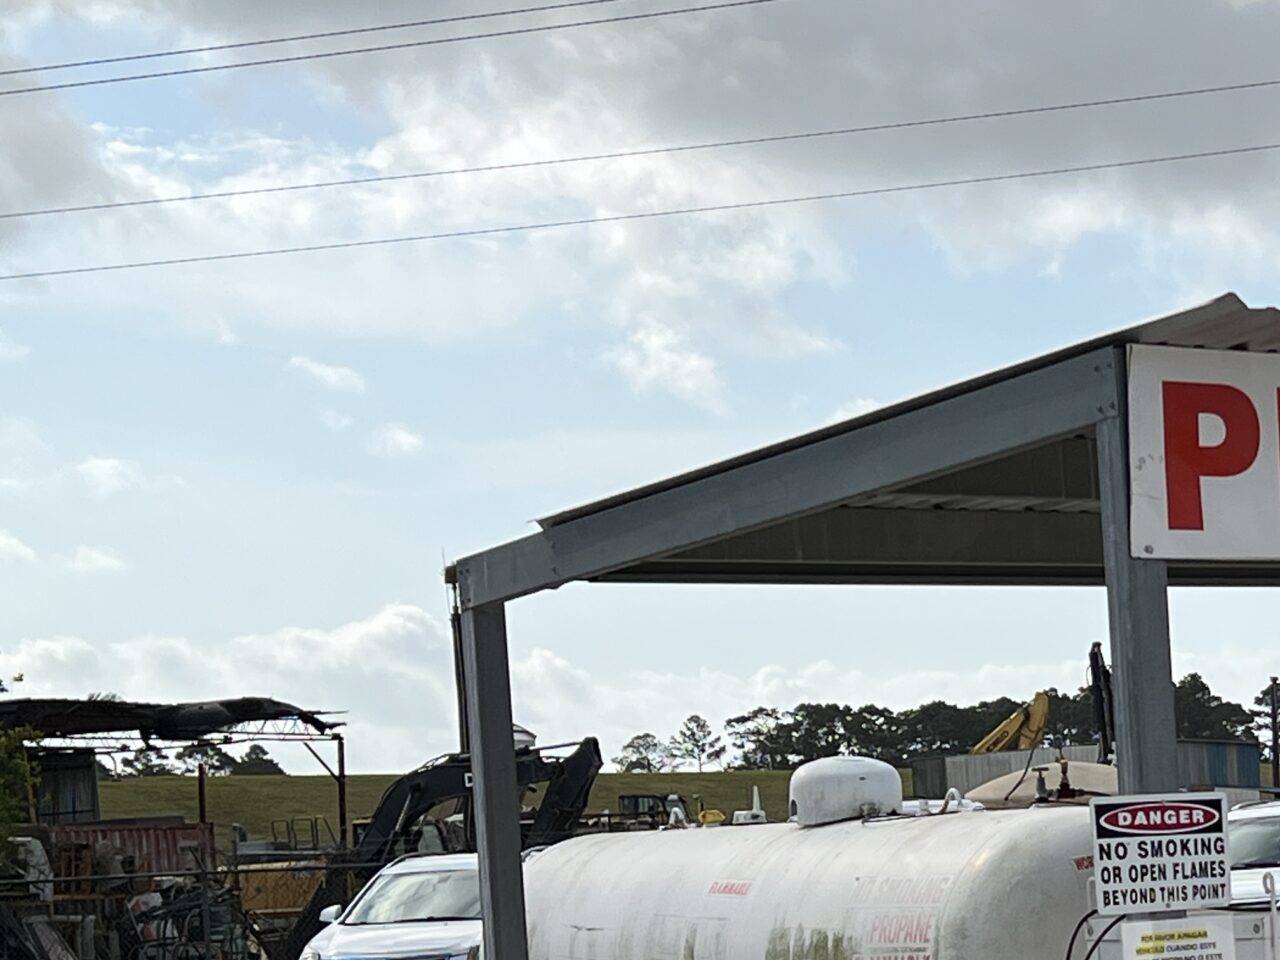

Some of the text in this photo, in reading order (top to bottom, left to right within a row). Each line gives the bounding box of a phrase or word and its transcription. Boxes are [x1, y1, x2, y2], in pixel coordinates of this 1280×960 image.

[1118, 810, 1205, 826] DANGER
[1099, 837, 1225, 860] NO SMOKING
[1101, 860, 1226, 884] OR OPEN FLAMES
[1103, 883, 1226, 907] BEYOND THIS POINT
